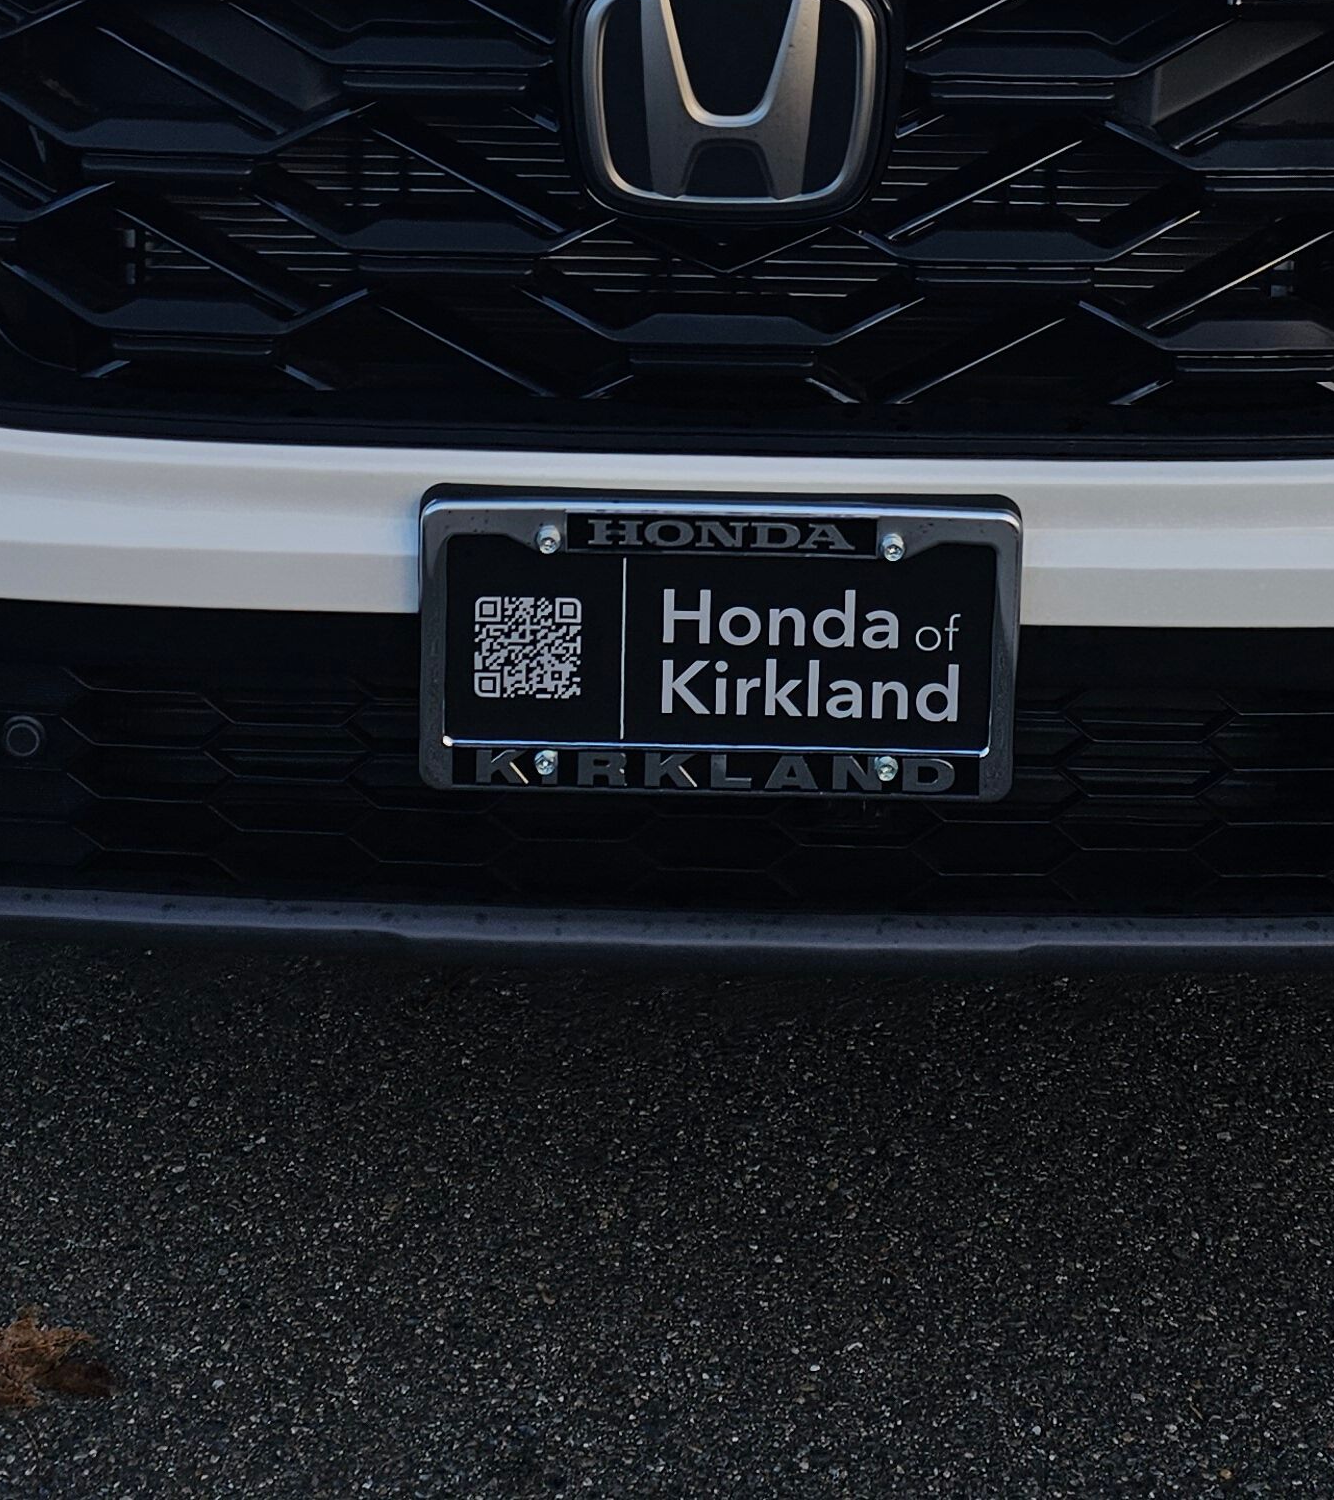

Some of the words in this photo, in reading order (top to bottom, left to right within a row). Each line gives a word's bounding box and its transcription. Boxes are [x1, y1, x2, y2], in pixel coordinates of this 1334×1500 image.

[587, 518, 856, 550] HONDA
[662, 588, 899, 650] Honda
[915, 613, 962, 651] of
[661, 658, 960, 723] Kirkland
[475, 749, 956, 793] KIRKLAND
